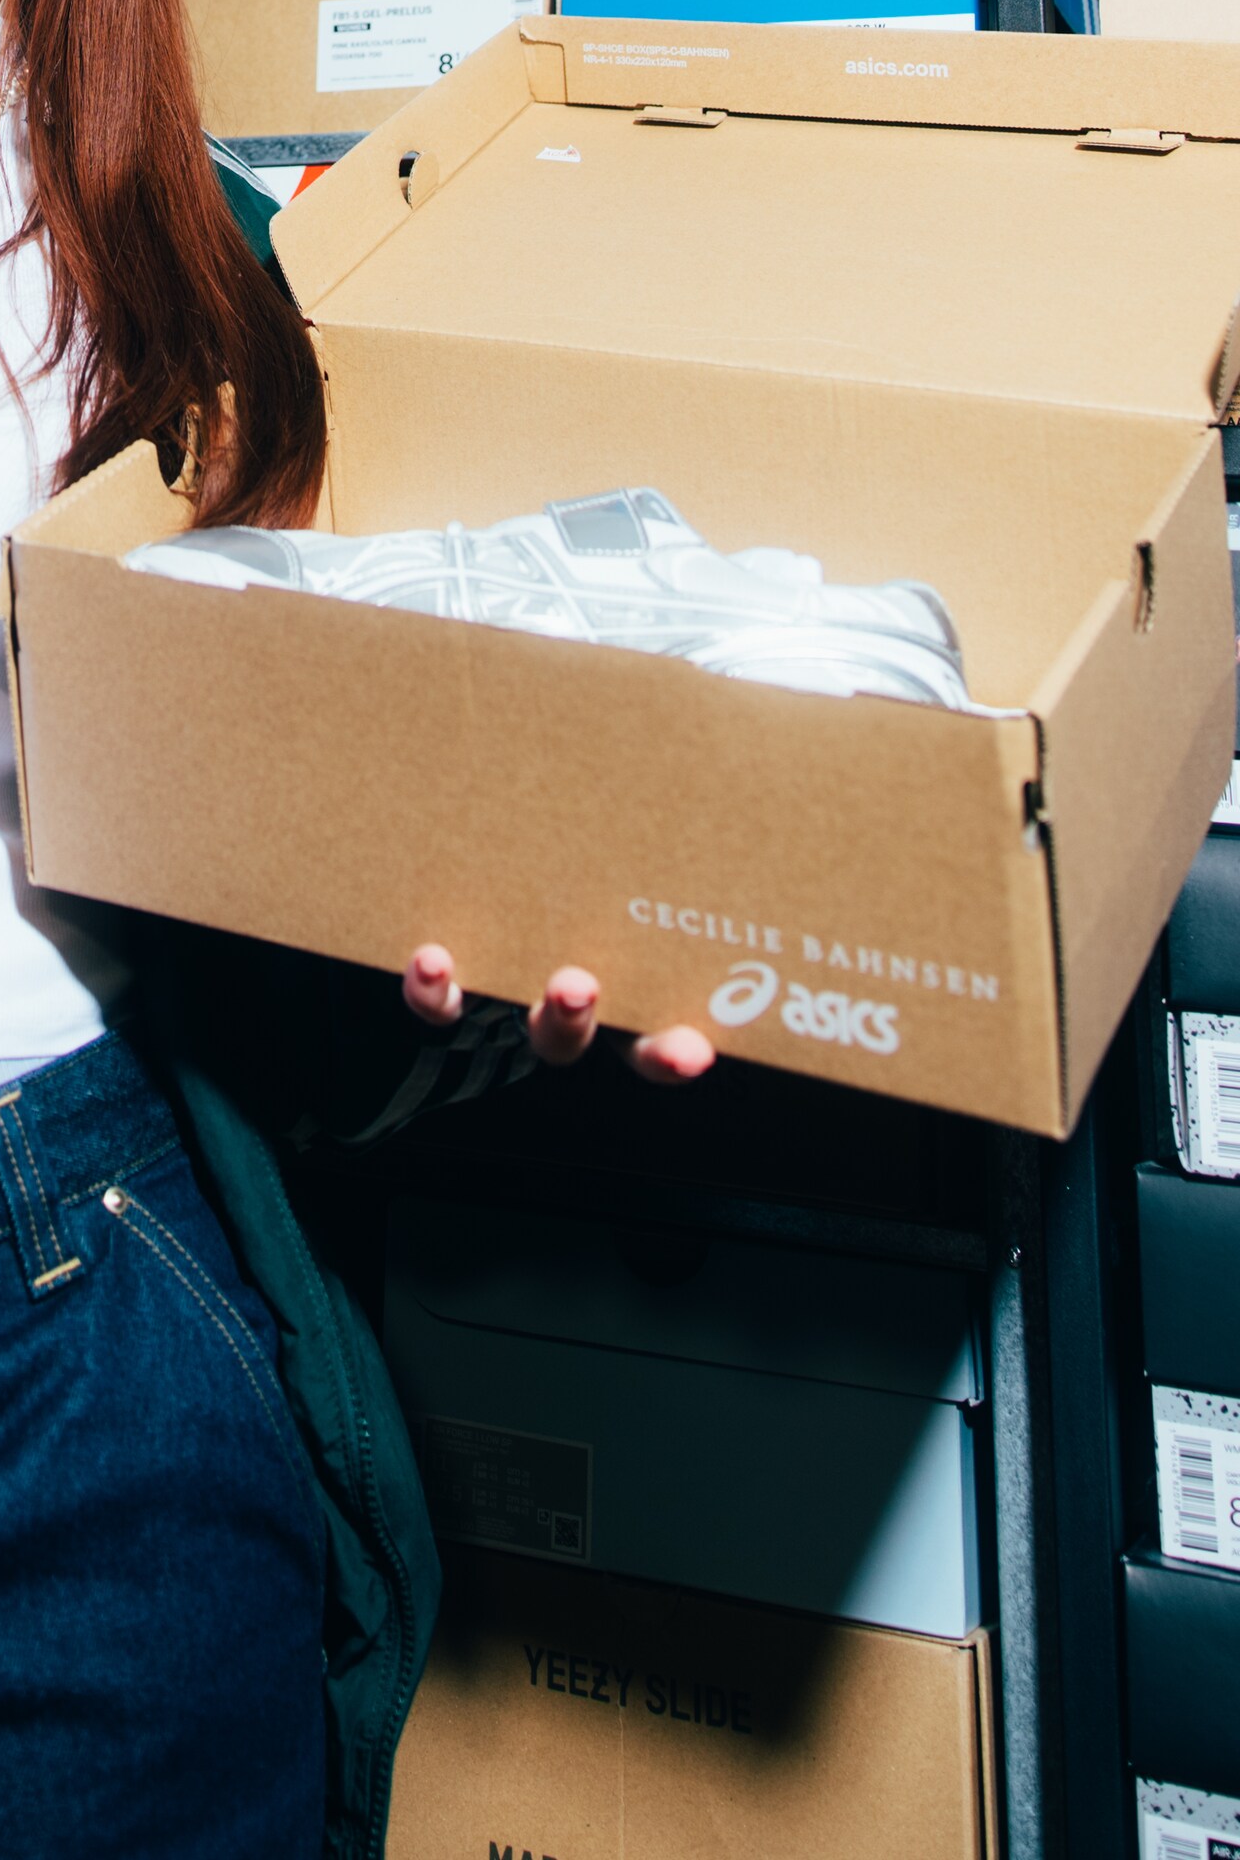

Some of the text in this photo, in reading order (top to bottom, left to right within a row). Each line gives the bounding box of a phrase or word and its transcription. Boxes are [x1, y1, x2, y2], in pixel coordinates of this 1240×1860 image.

[844, 56, 950, 79] asics.com
[628, 897, 999, 1002] CECILIE BAHNSEN
[781, 982, 900, 1056] asics
[524, 1645, 753, 1735] YEEZY SLIDE
